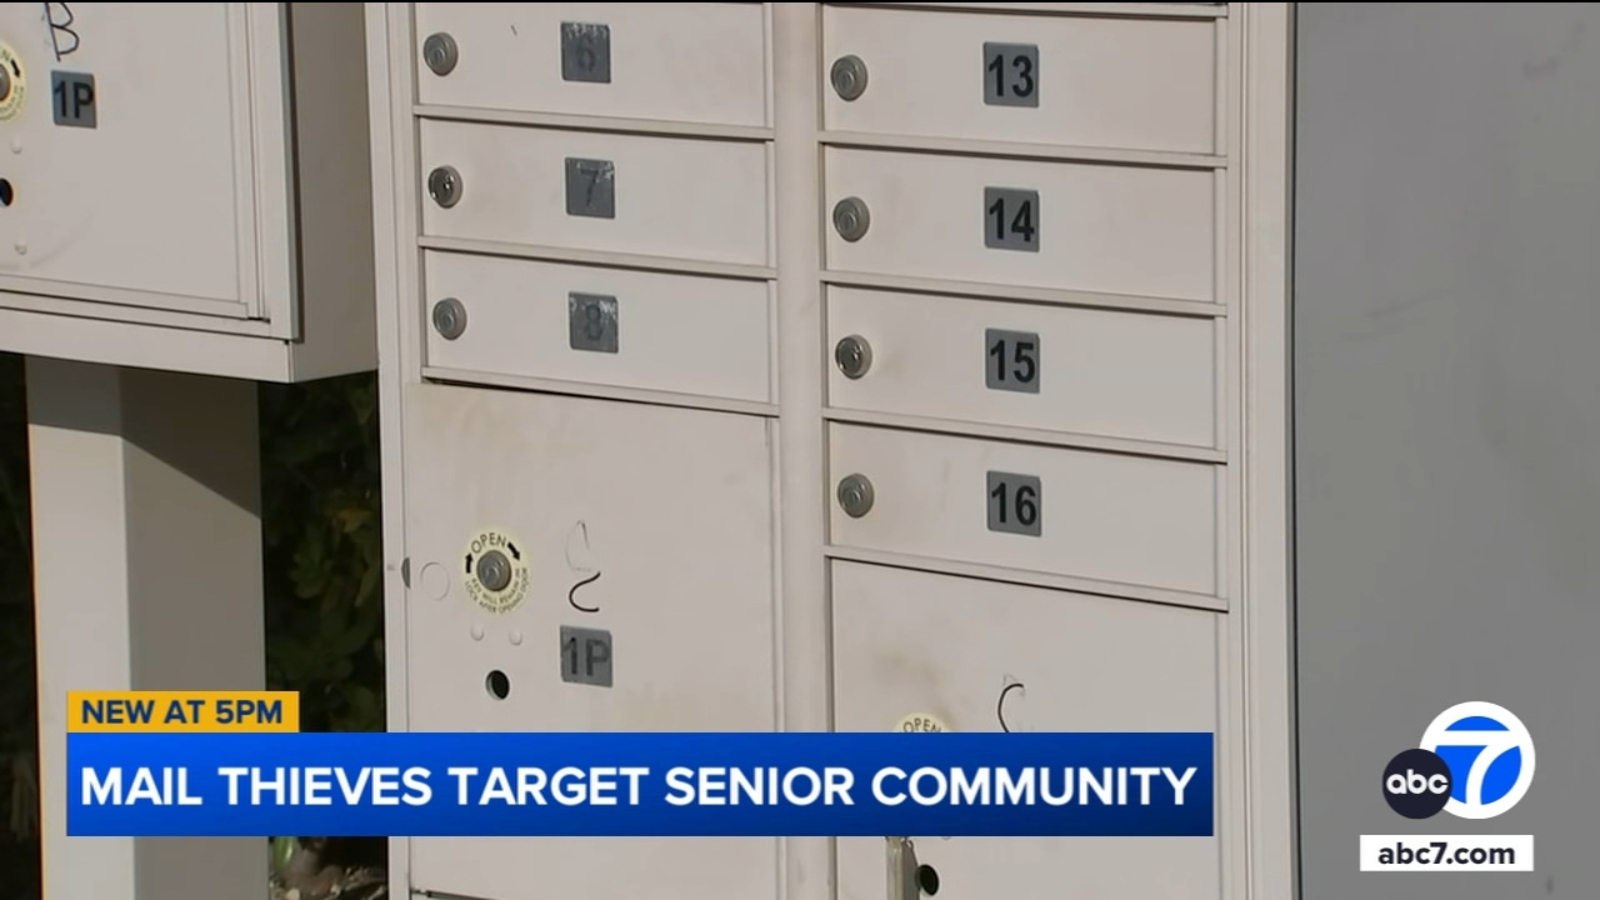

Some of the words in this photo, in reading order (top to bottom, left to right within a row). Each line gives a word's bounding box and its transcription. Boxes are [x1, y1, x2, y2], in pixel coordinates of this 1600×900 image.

[988, 54, 1034, 99] 13
[54, 80, 94, 119] 1P
[580, 167, 600, 207] 7
[988, 197, 1035, 243] 14
[584, 303, 604, 343] 8
[989, 339, 1036, 383] 15
[991, 482, 1037, 526] 16
[471, 532, 507, 554] OPEN
[561, 636, 611, 677] 1P
